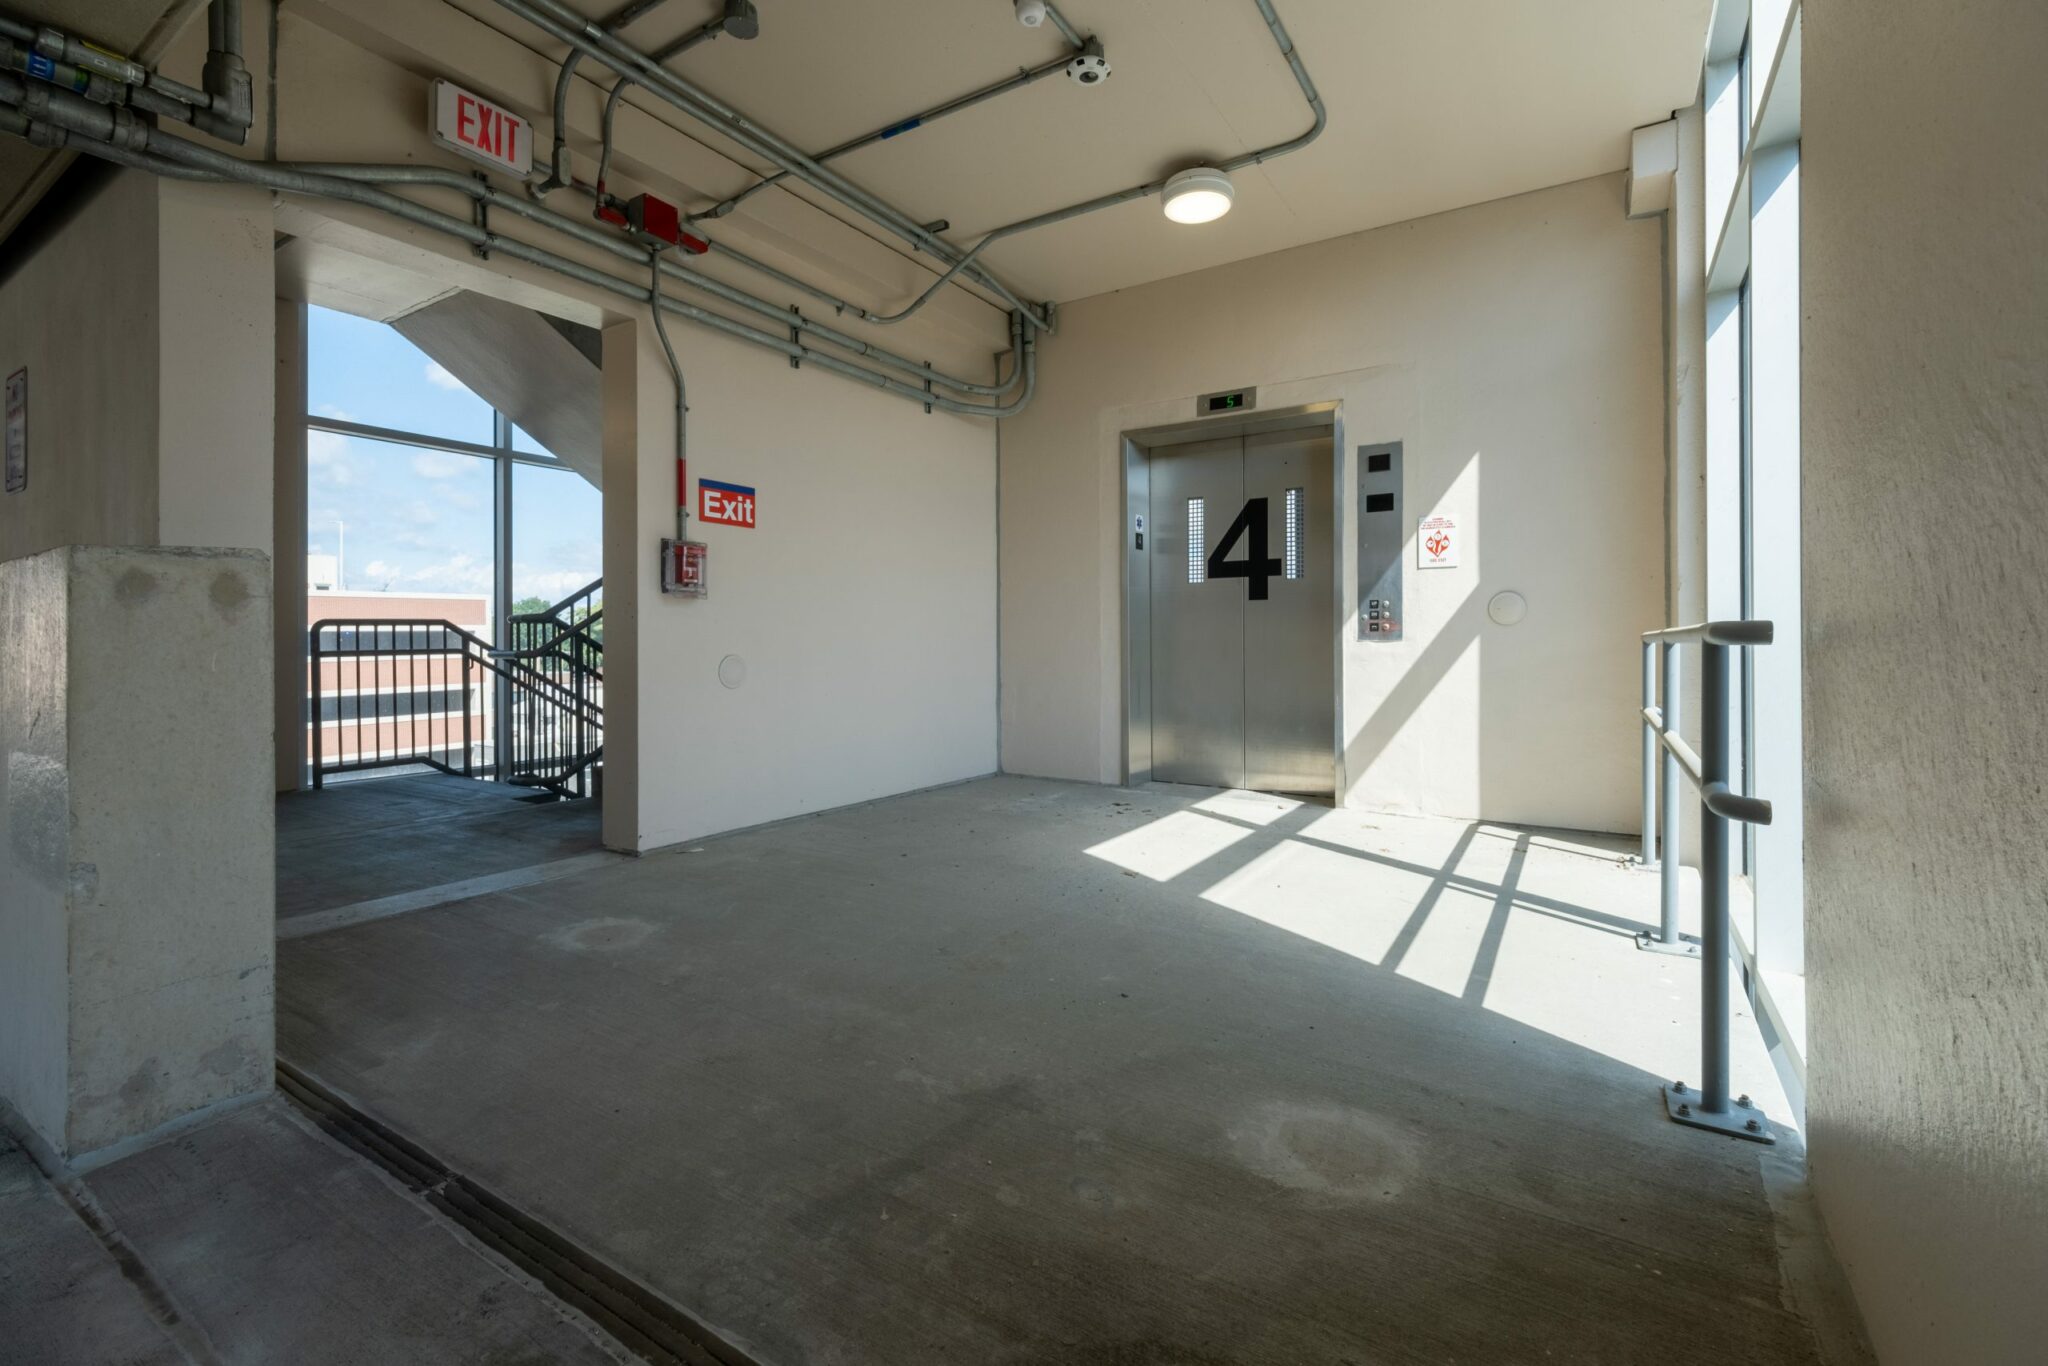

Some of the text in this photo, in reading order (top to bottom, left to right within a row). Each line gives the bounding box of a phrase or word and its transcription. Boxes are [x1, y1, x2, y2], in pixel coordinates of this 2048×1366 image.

[457, 94, 519, 163] EXIT
[1226, 395, 1234, 408] 5
[703, 490, 753, 524] Exit
[1207, 497, 1282, 600] 4
